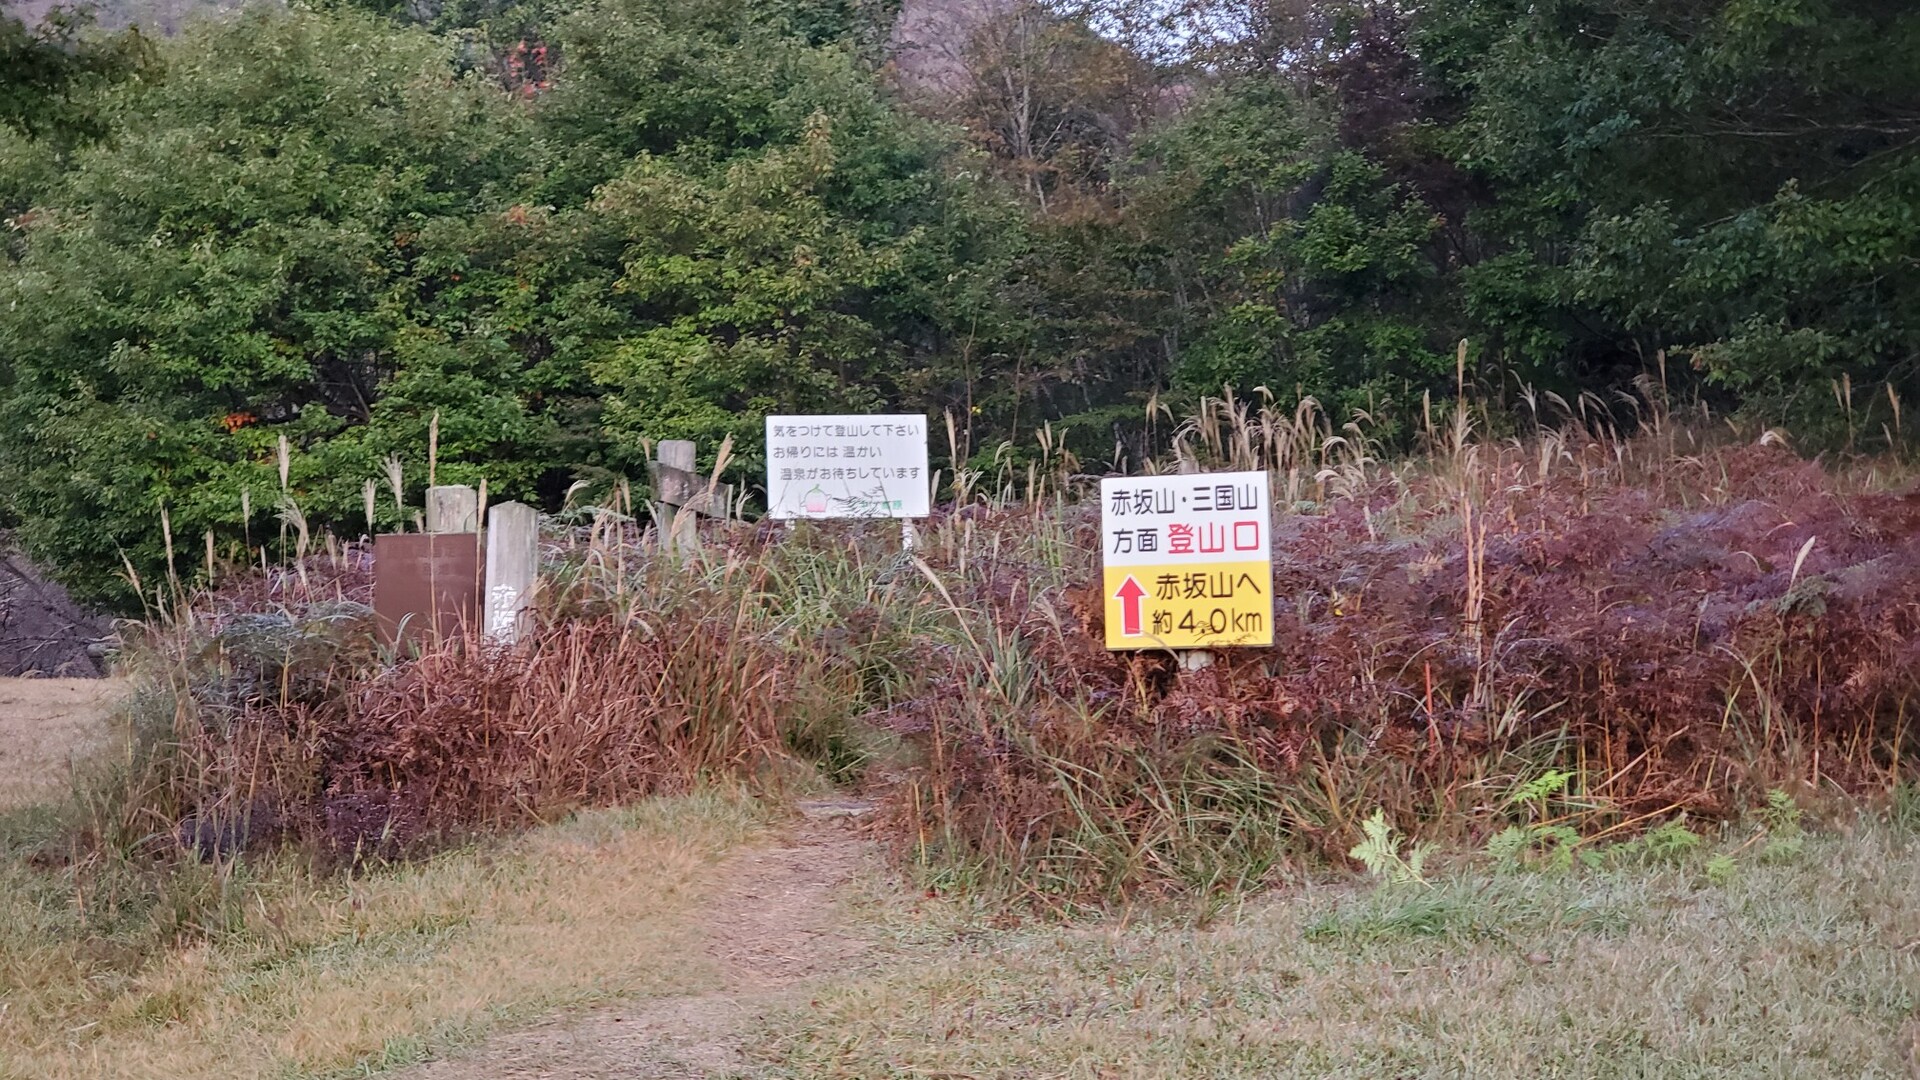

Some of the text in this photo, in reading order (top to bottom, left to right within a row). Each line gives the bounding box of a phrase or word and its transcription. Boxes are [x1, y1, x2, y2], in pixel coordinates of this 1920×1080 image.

[773, 424, 919, 438] 気をつけて登山して下さい
[780, 467, 921, 481] 温泉がお待ちしています
[1111, 483, 1258, 516] 赤坂山・三国山
[1156, 571, 1261, 600] 赤坂山へ
